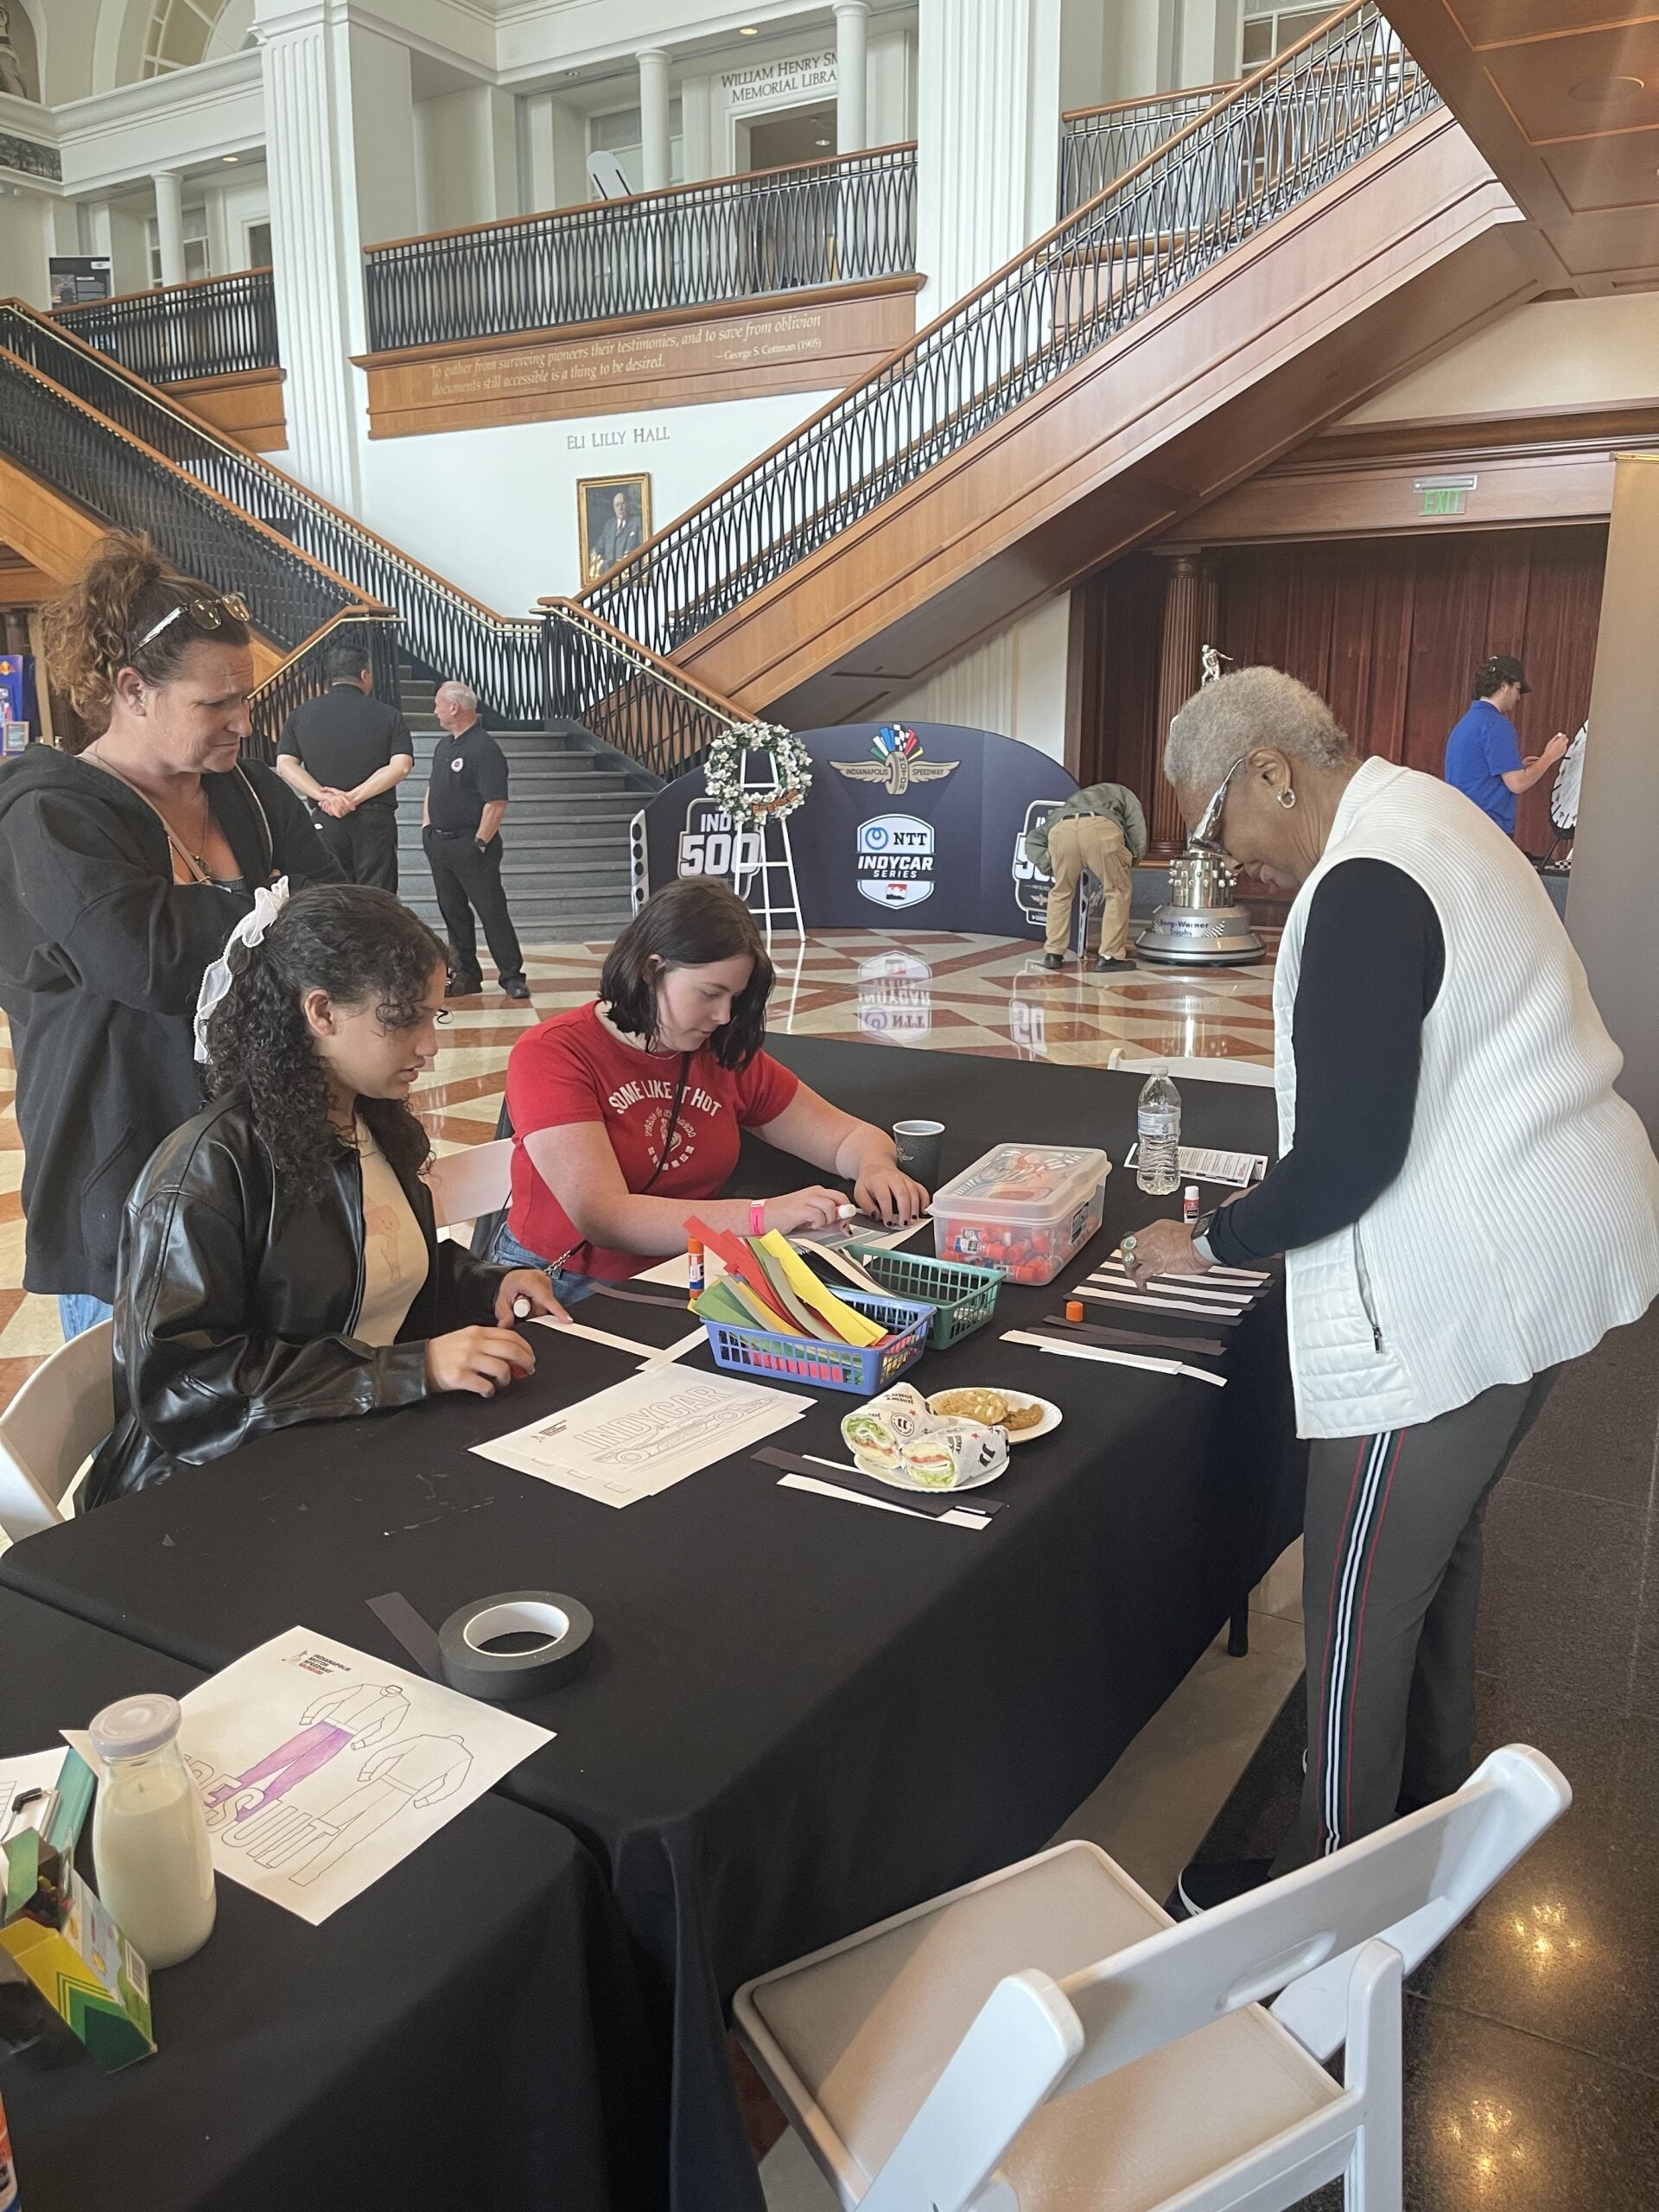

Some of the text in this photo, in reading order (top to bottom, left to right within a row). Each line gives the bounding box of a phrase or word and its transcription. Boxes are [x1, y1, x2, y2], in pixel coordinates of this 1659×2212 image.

[721, 52, 837, 88] WILLIAM HENRY SM
[732, 69, 837, 103] MEMORIAL LIBRA
[429, 313, 821, 380] To gather from surviving pioneers their testimonies, and to save from oblivion
[753, 347, 761, 356] S.
[761, 343, 796, 355] Cottman
[798, 338, 822, 352] (1905)
[432, 353, 666, 397] documents still accessible is a thing to be desired.
[567, 426, 671, 450] ELI LILLY HALL
[899, 756, 907, 791] MOTOR
[700, 813, 742, 832] IND
[893, 832, 927, 846] NTT
[679, 834, 760, 876] 500
[857, 855, 934, 871] INDYCAR
[873, 869, 918, 879] SERIES
[608, 1081, 645, 1115] SOME
[640, 1080, 673, 1099] LIKE
[690, 1088, 722, 1117] HOT
[573, 1385, 732, 1451] INDYCAR
